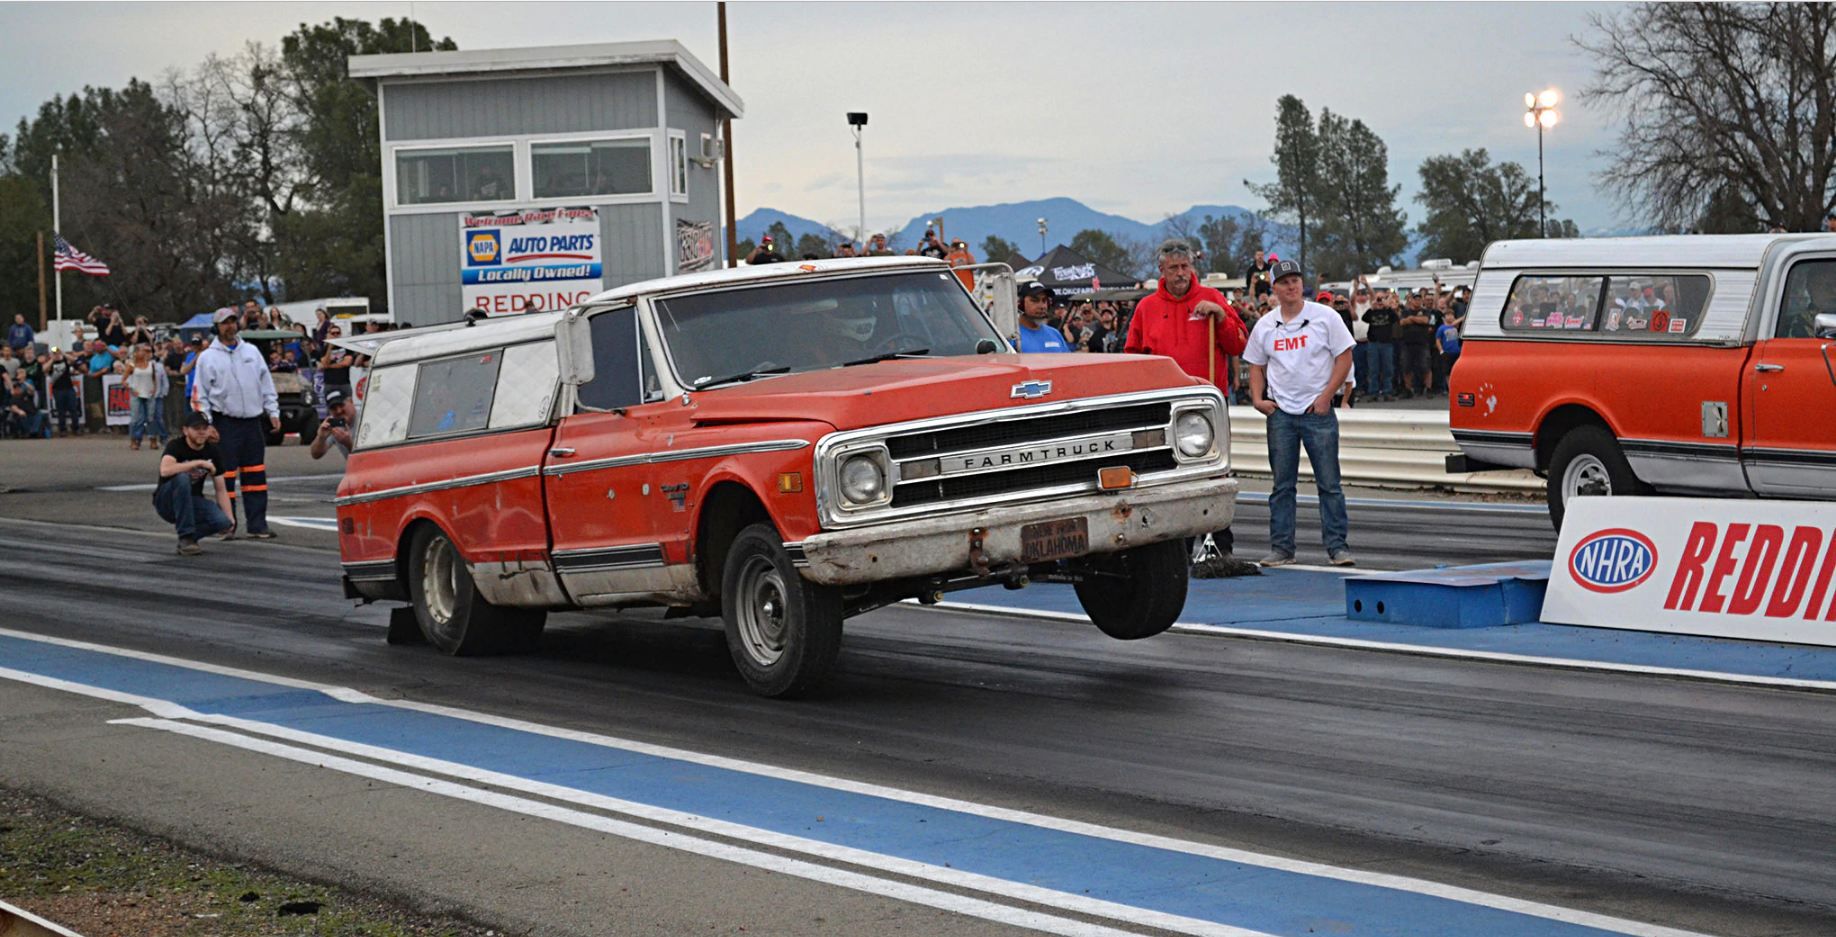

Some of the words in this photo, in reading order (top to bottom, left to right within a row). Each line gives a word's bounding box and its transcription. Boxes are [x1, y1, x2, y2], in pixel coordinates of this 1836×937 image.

[473, 241, 494, 254] NAPA
[508, 236, 547, 254] AUTO
[549, 234, 594, 252] PARTS
[477, 267, 532, 282] Locally
[533, 264, 591, 279] Owned!
[1273, 335, 1309, 352] EMT
[964, 440, 1115, 469] FARMTRUCK
[1024, 533, 1086, 559] OKLAHOMA
[1580, 539, 1644, 582] NHRA
